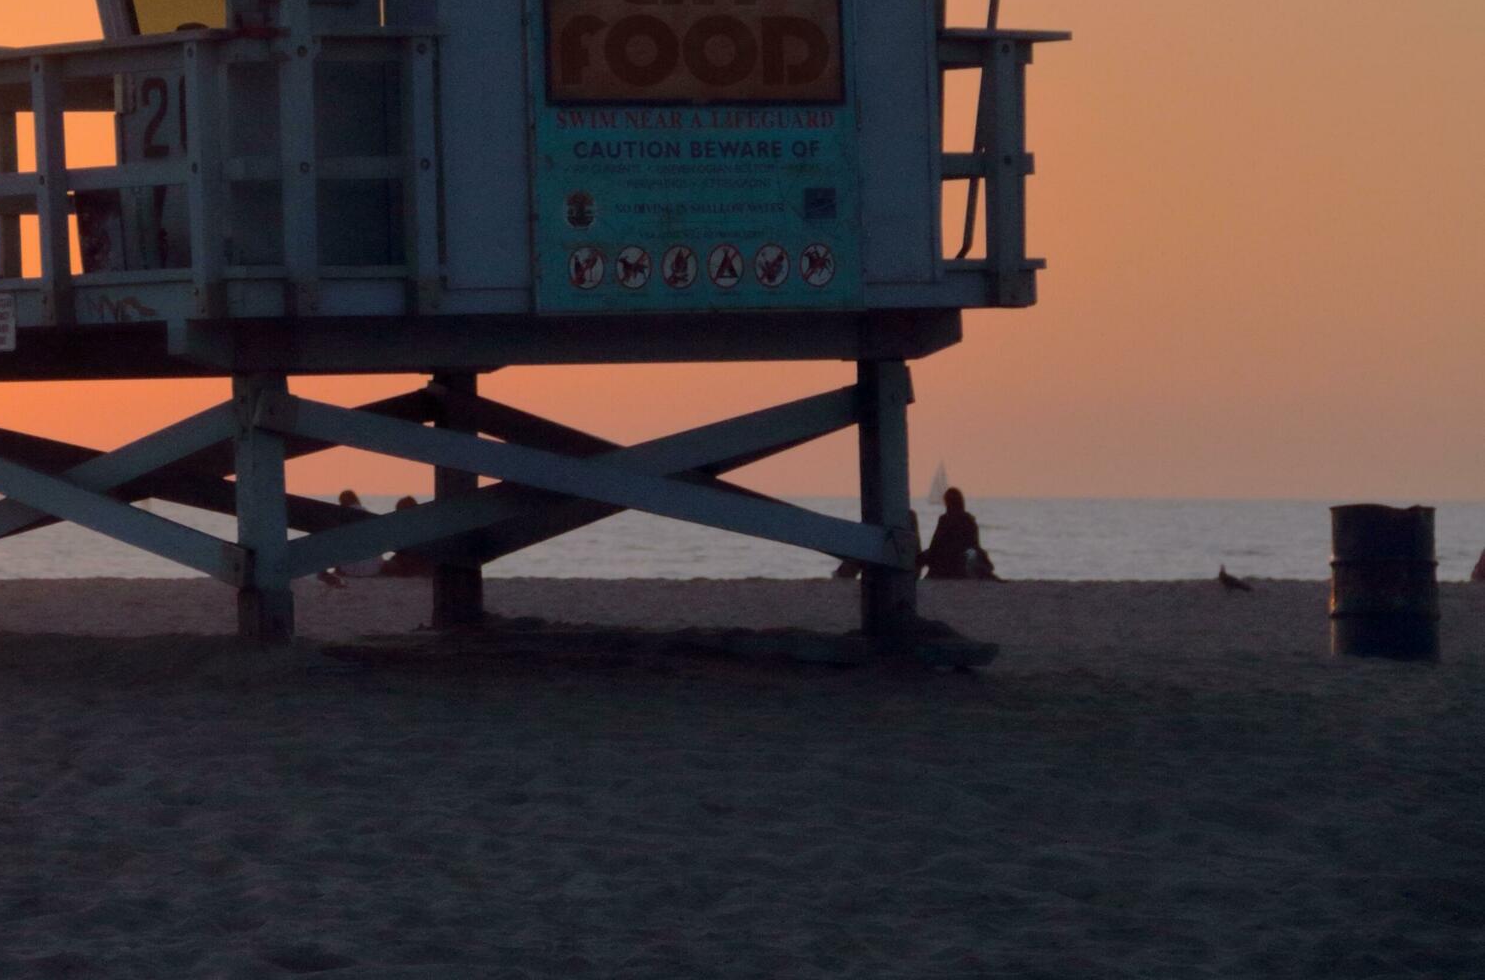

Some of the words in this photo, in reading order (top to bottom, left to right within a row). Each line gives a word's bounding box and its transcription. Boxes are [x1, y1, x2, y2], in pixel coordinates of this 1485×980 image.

[559, 14, 830, 87] FOOD
[555, 109, 617, 129] SWIM
[625, 109, 683, 129] NEAR
[690, 110, 707, 129] A
[711, 109, 835, 129] LIFEGUARD
[573, 140, 681, 159] CAUTION
[690, 140, 782, 159] BEWARE
[791, 140, 820, 159] OF
